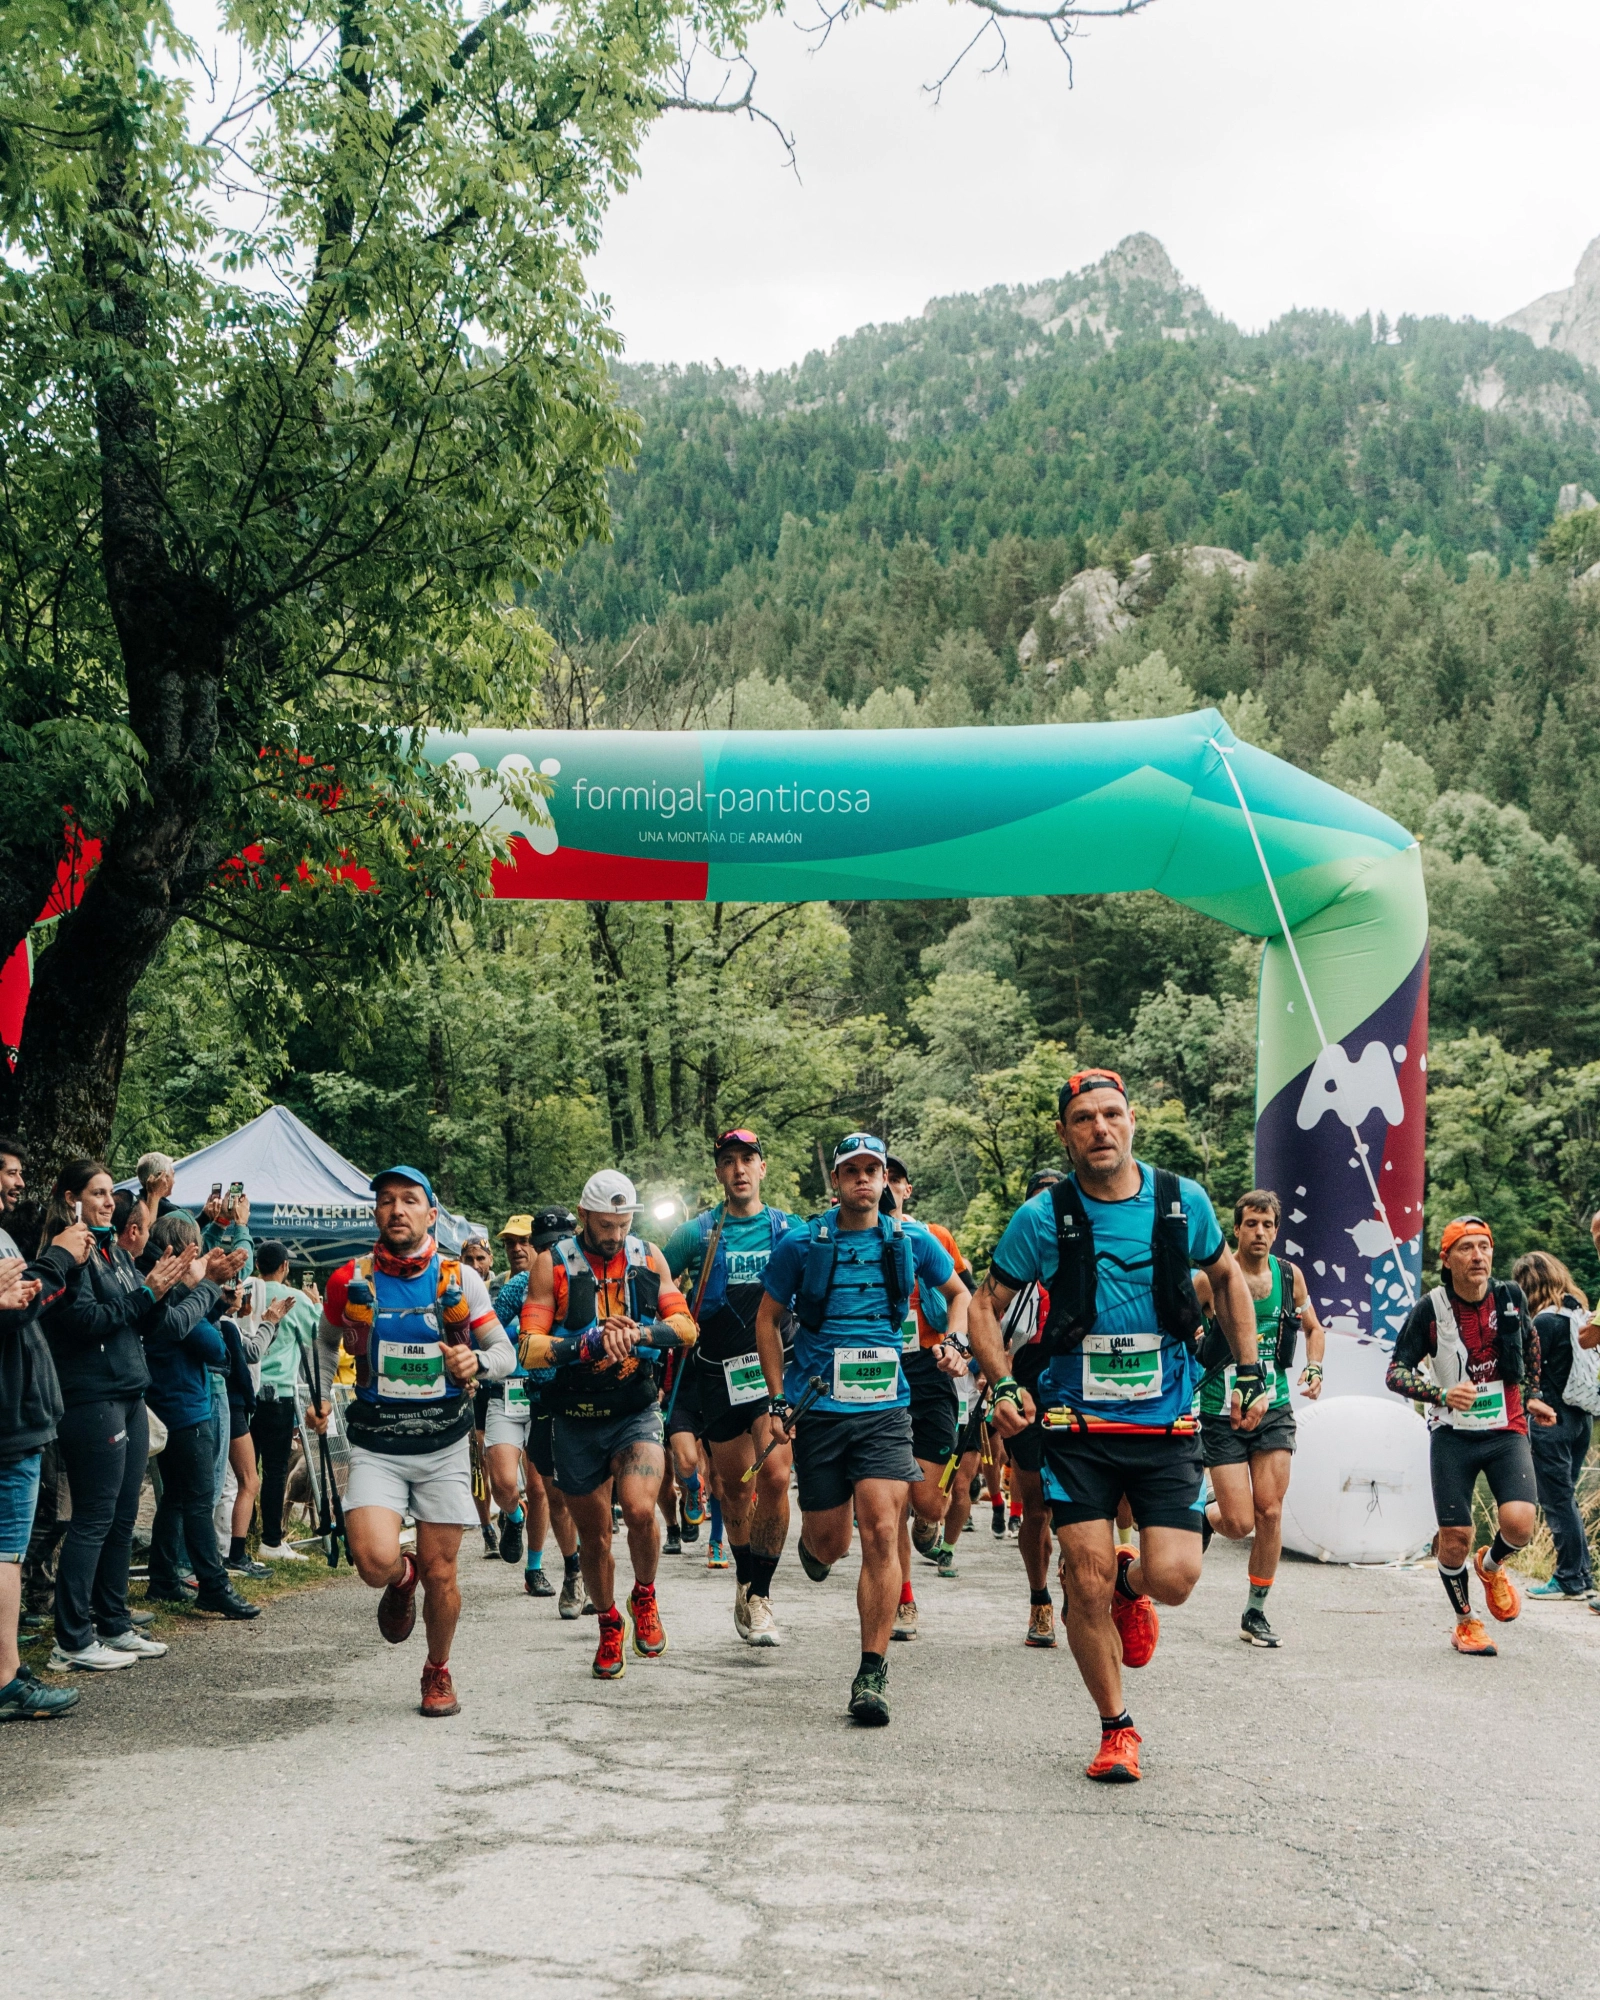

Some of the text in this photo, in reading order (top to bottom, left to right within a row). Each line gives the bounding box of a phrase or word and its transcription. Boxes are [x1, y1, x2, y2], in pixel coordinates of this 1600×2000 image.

[572, 778, 870, 819] formigal-panticosa
[638, 829, 802, 844] UNA MONTAÑA DE ARAMÓN
[272, 1217, 319, 1229] building
[324, 1220, 338, 1229] up
[1108, 1337, 1135, 1348] TRAIL
[402, 1345, 425, 1355] TRAIL
[857, 1349, 878, 1359] TRAIL
[400, 1363, 429, 1373] 4365
[1108, 1357, 1140, 1369] 4144
[744, 1369, 763, 1380] 408
[856, 1366, 882, 1377] 4289
